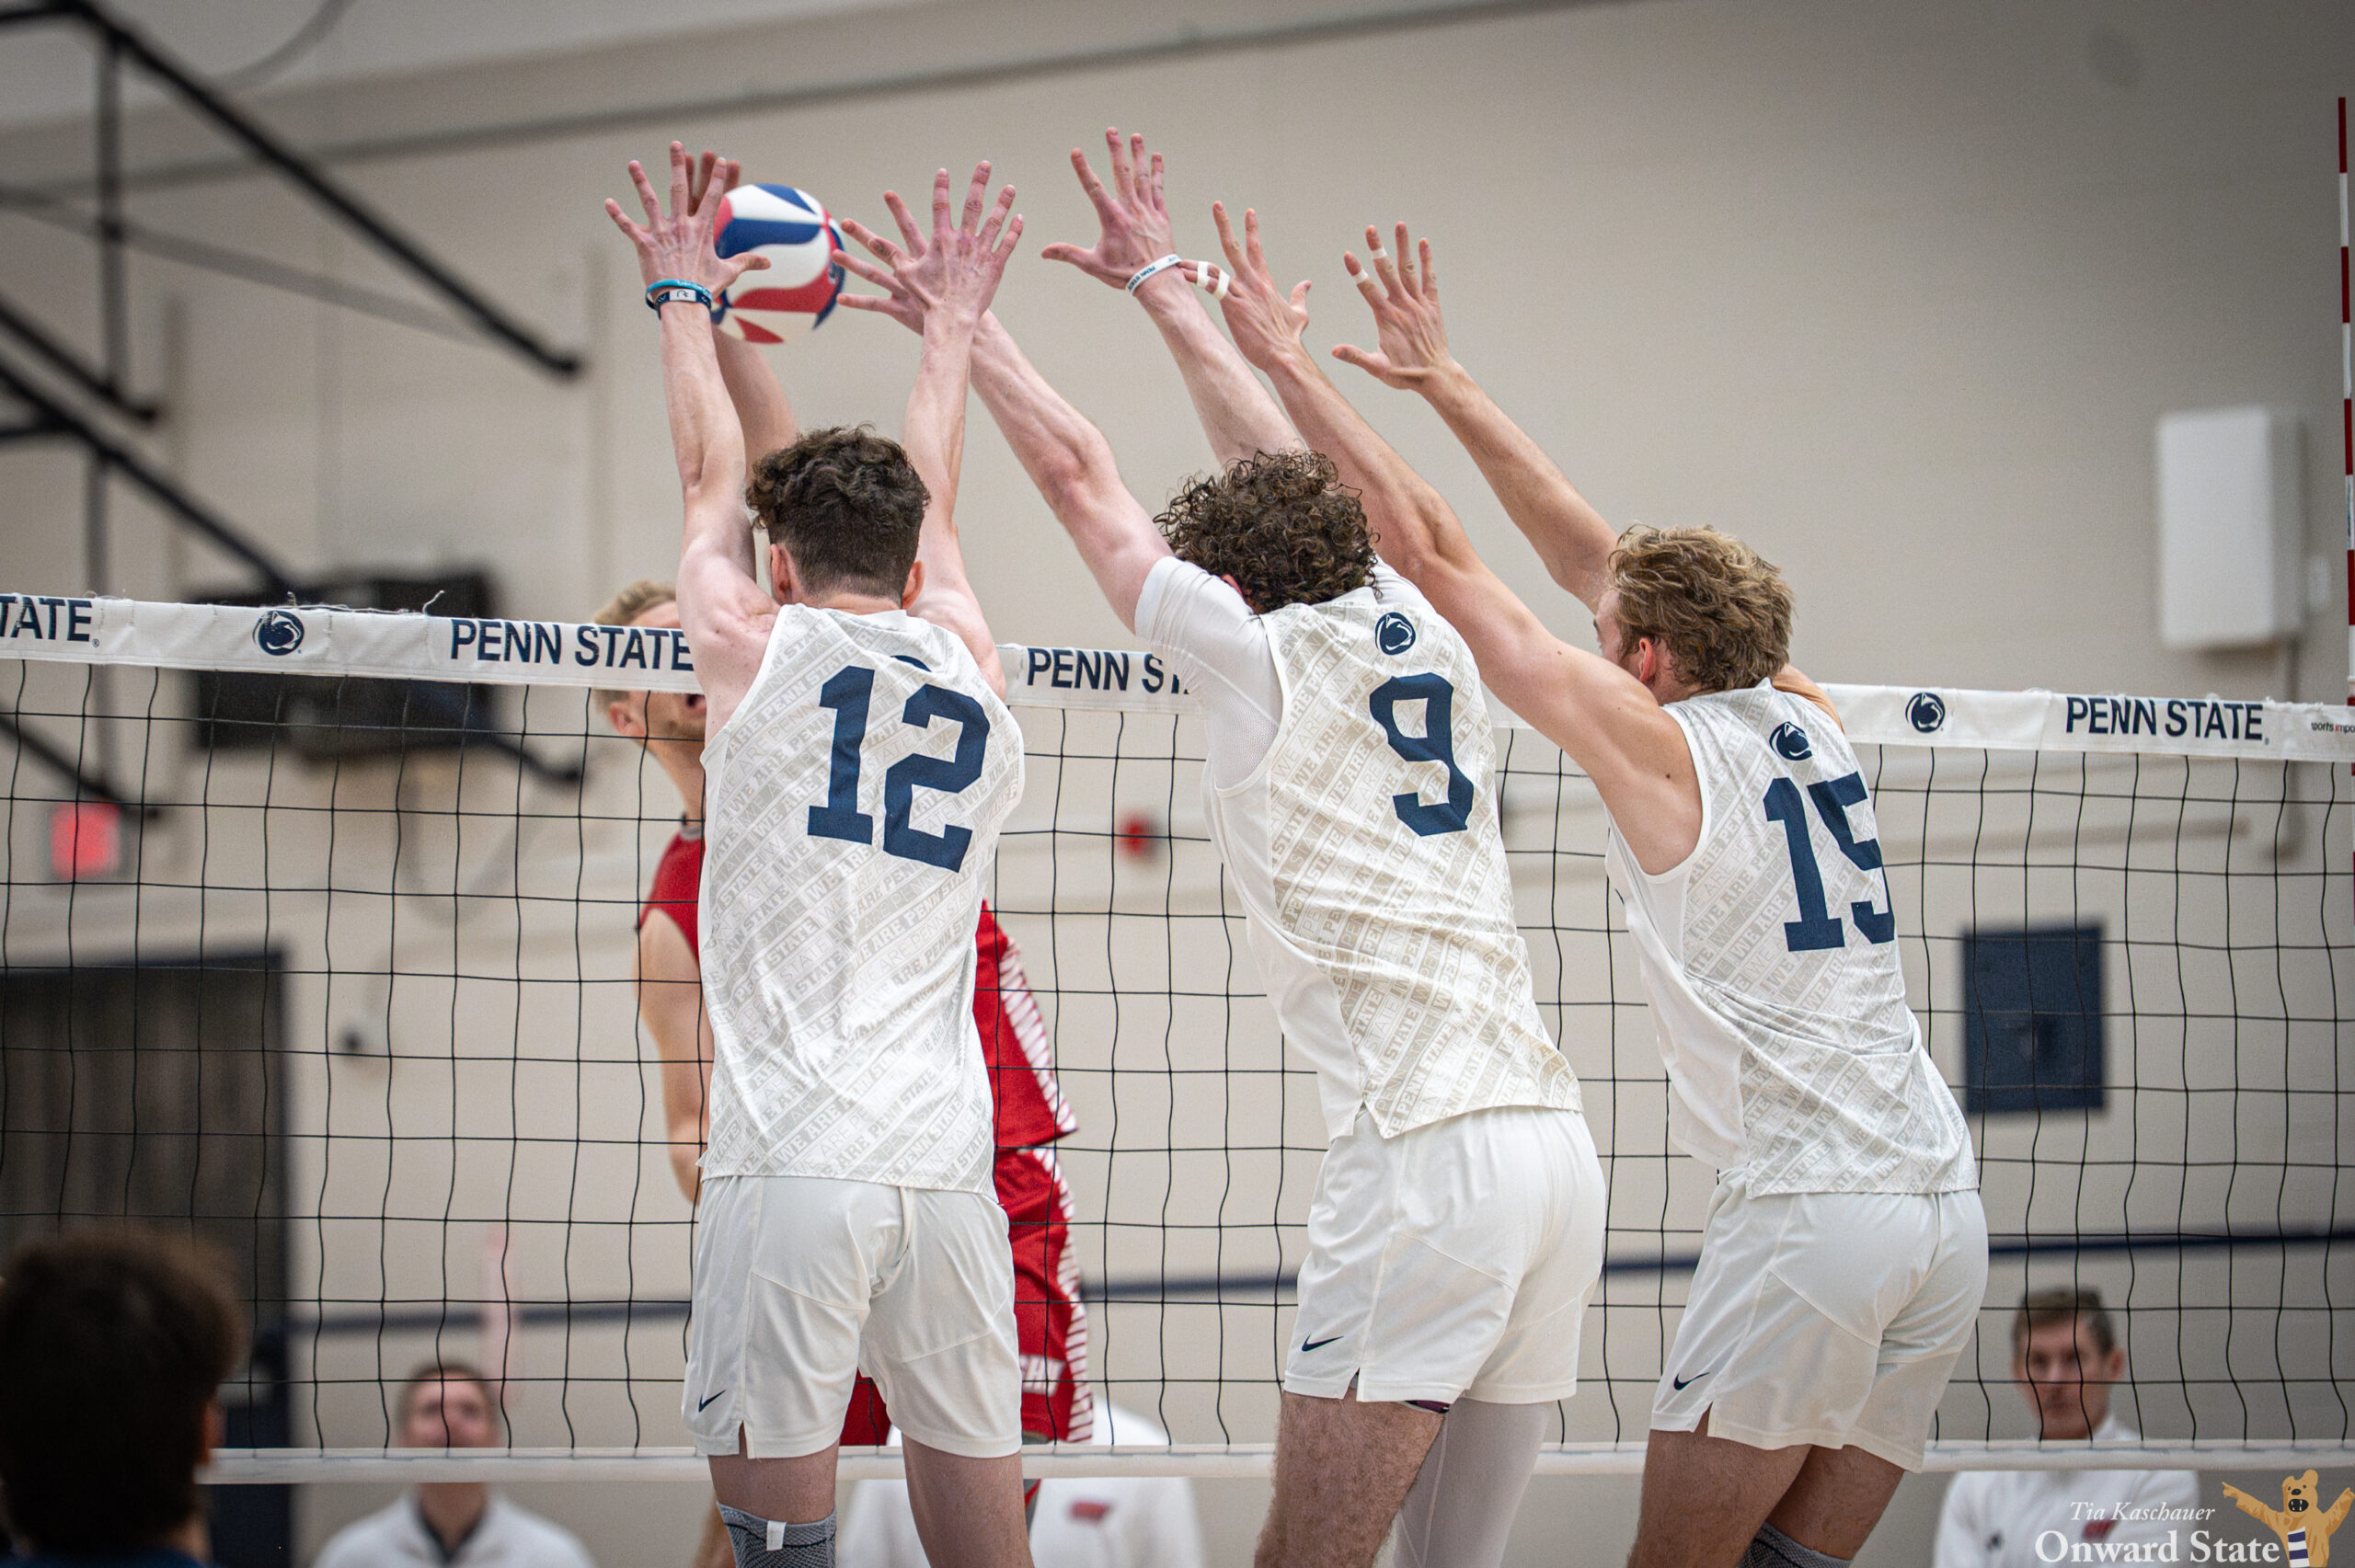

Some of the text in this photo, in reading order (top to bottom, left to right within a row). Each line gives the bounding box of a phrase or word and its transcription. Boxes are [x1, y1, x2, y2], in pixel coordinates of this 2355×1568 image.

[451, 619, 694, 671] PENN STATE
[1027, 647, 1130, 691] PENN
[808, 665, 991, 874] 12
[1369, 671, 1474, 837] 9
[2066, 696, 2264, 741] PENN STATE
[1763, 772, 1895, 952] 15
